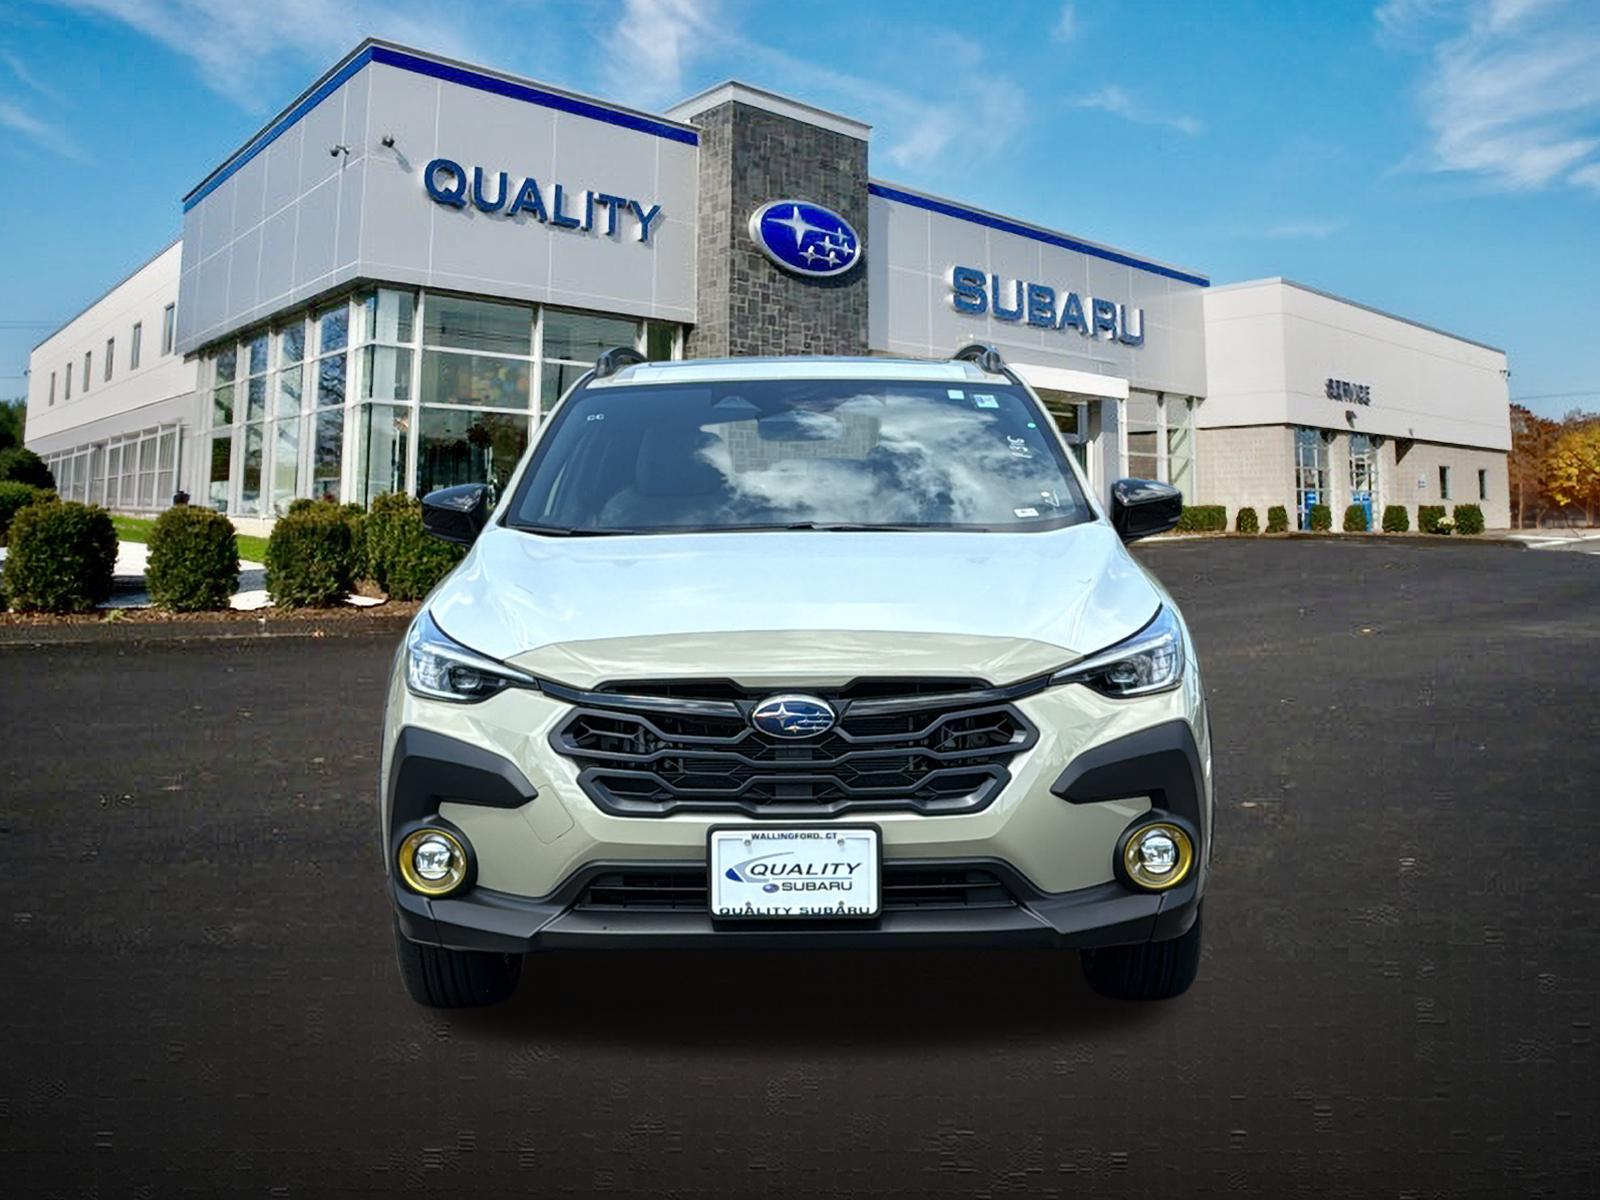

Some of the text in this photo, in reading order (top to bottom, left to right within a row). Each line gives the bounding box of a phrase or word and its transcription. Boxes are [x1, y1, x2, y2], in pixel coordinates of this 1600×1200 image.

[424, 158, 661, 242] QUALITY
[952, 265, 1144, 346] SUBARU
[750, 863, 862, 876] QUALITY
[781, 882, 853, 891] SUBARU
[719, 907, 870, 915] QUALITY SUBARU
